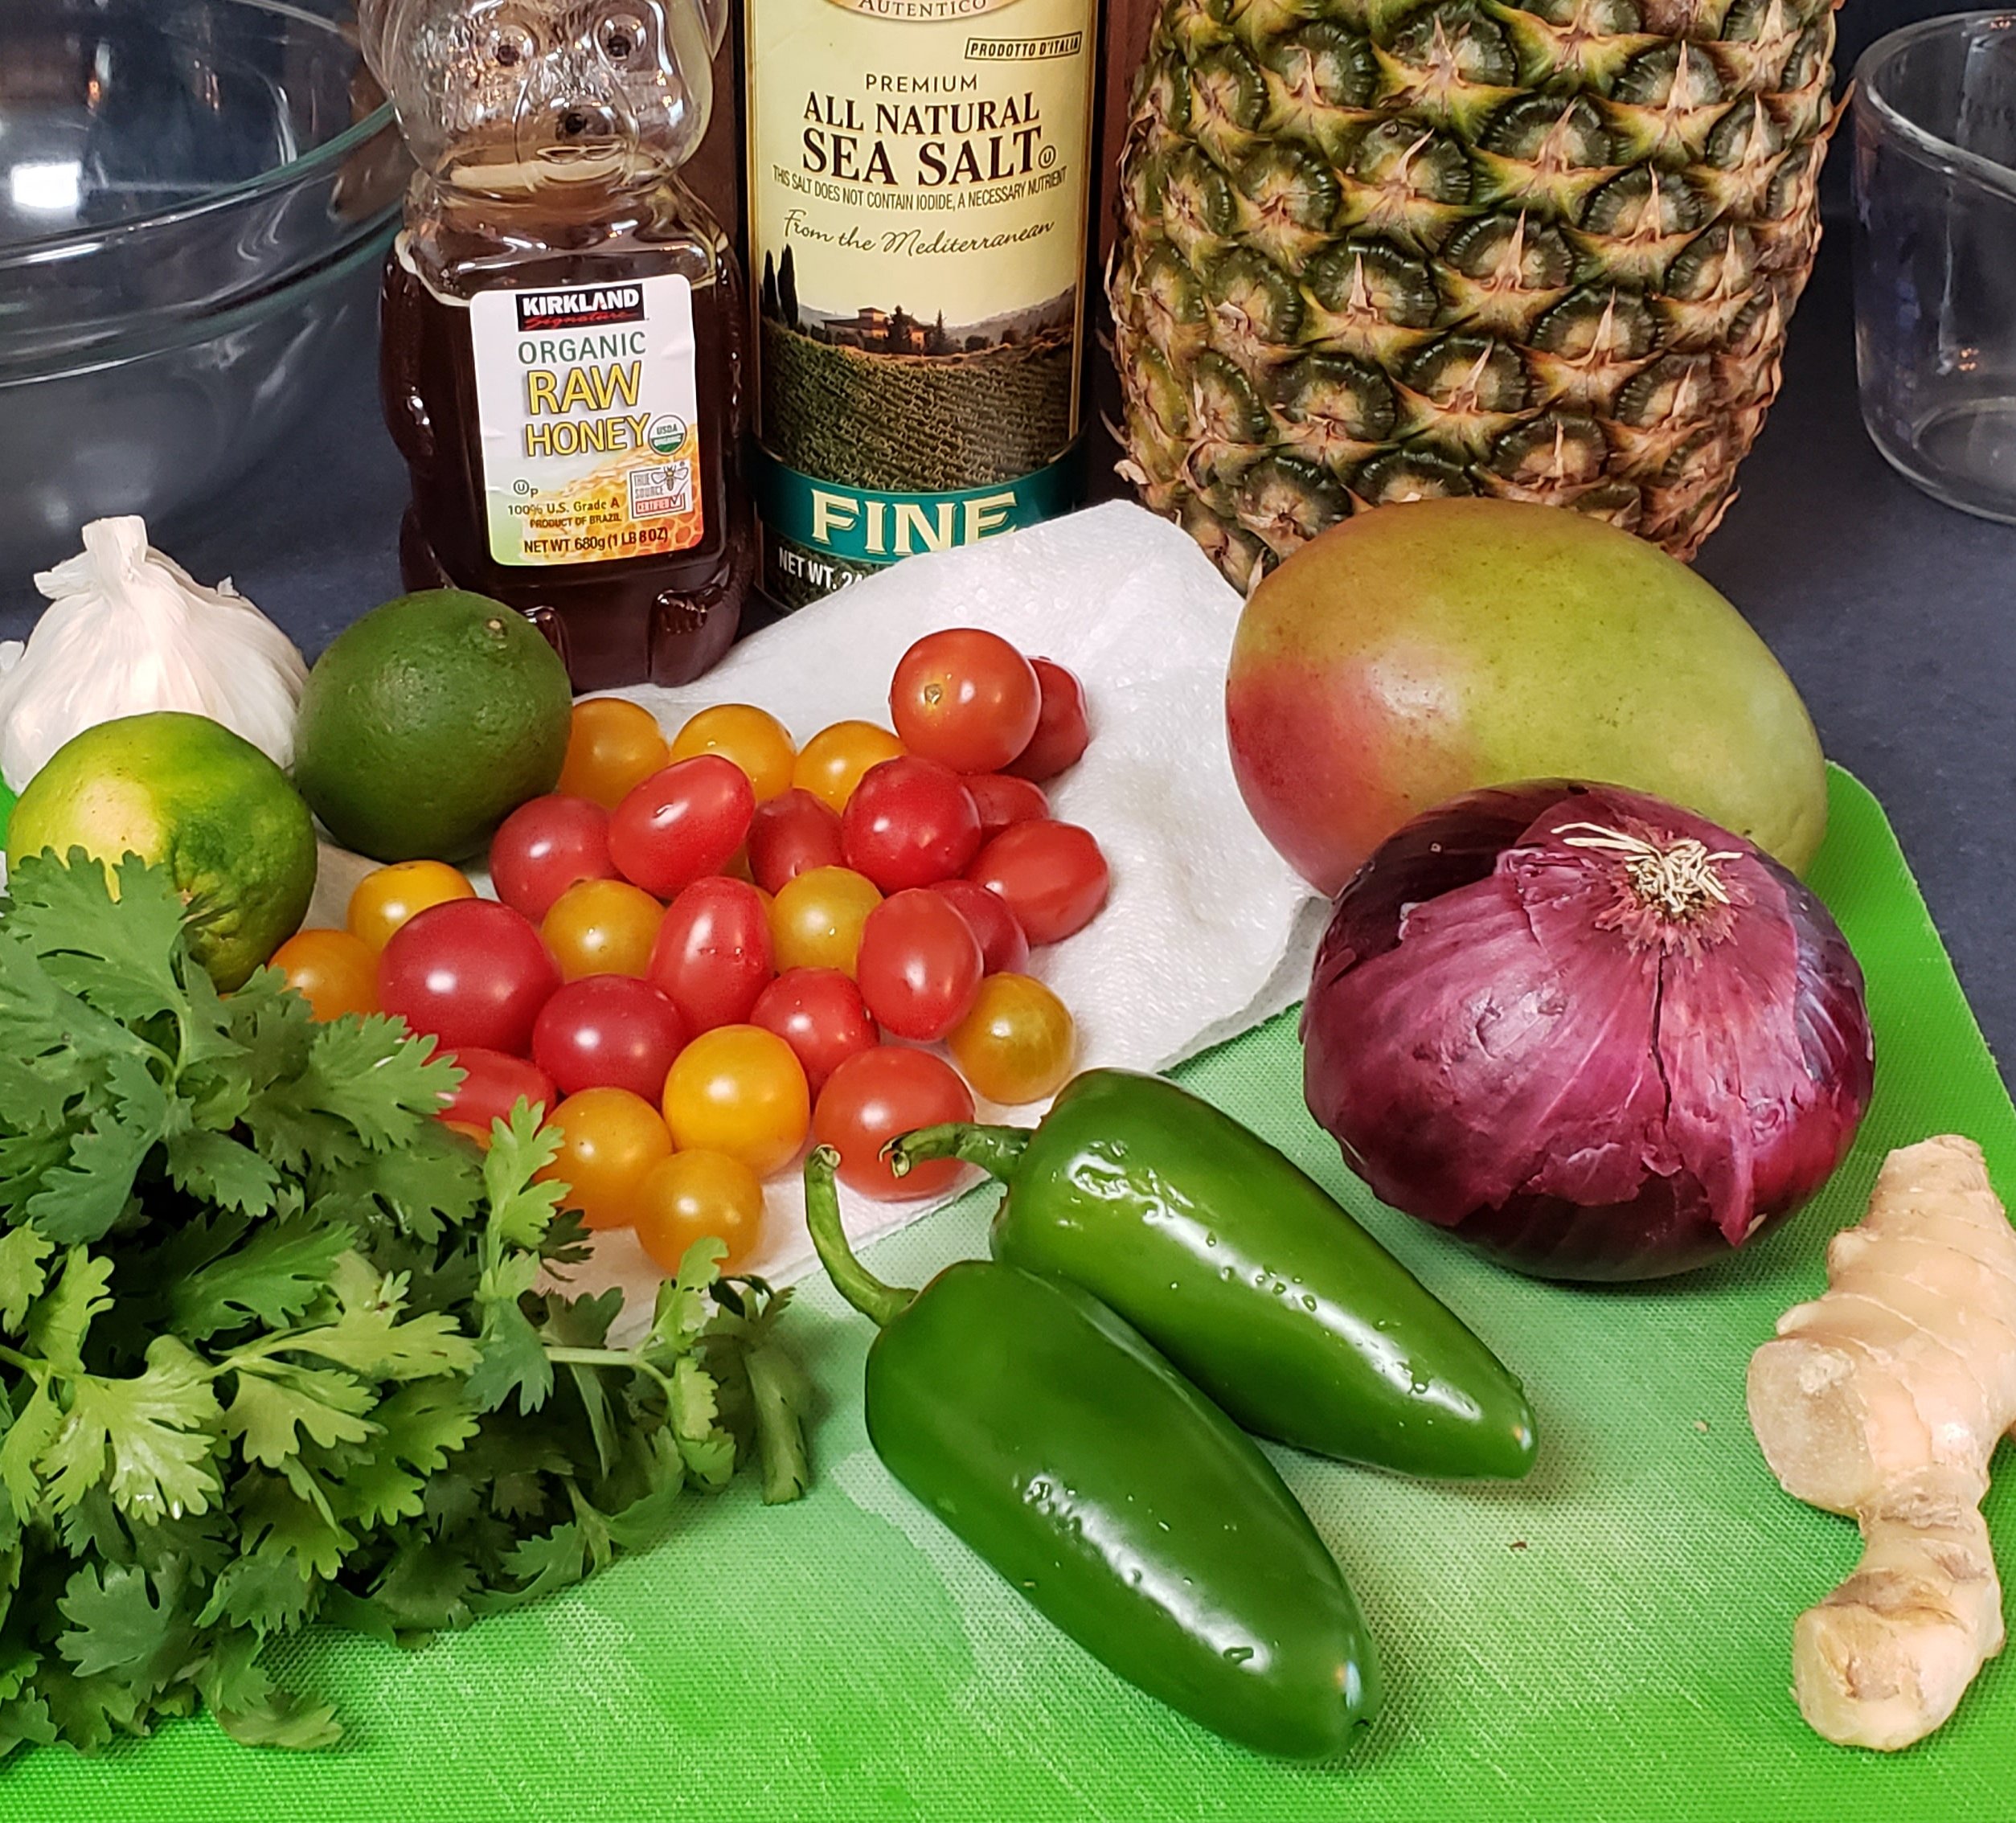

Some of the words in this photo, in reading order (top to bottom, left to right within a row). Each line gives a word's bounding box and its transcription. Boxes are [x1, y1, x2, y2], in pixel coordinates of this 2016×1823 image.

[858, 0, 986, 17] AUTENTICO
[969, 43, 1036, 57] PRODOTTO
[1039, 36, 1079, 55] D'ITALIA
[866, 73, 977, 93] PREMIUM
[804, 92, 864, 132] ALL
[875, 92, 1040, 136] NATURAL
[803, 127, 899, 186] SEA
[918, 126, 1043, 186] SALT
[772, 164, 790, 187] THIS
[792, 173, 813, 195] SALT
[814, 181, 840, 203] DOES
[843, 187, 864, 207] NOT
[867, 191, 914, 211] CONTAIN
[916, 193, 956, 211] IODIDE,
[957, 193, 965, 208] A
[969, 181, 1026, 207] NECESSARY
[1027, 166, 1067, 195] NUTRIENT
[784, 208, 834, 238] From
[838, 226, 876, 251] the
[881, 221, 1055, 256] Mediterranean
[522, 288, 640, 317] KIRKLAND
[524, 310, 640, 330] Signature
[518, 331, 646, 365] ORGANIC
[527, 360, 642, 415] RAW
[525, 412, 650, 457] HONEY
[656, 424, 678, 435] USDA
[508, 504, 543, 515] 100%
[547, 502, 569, 514] U.S.
[573, 499, 607, 512] Grade
[610, 497, 620, 508] A
[530, 518, 572, 528] PRODUCT
[575, 516, 587, 526] OF
[589, 513, 621, 524] BRAZIL
[811, 488, 1018, 557] FINE
[524, 539, 548, 553] NET
[550, 539, 571, 552] WT
[574, 537, 605, 551] 680g
[608, 532, 618, 549] (1
[621, 531, 637, 545] LB
[779, 547, 805, 578] NET
[808, 559, 838, 590] WT.
